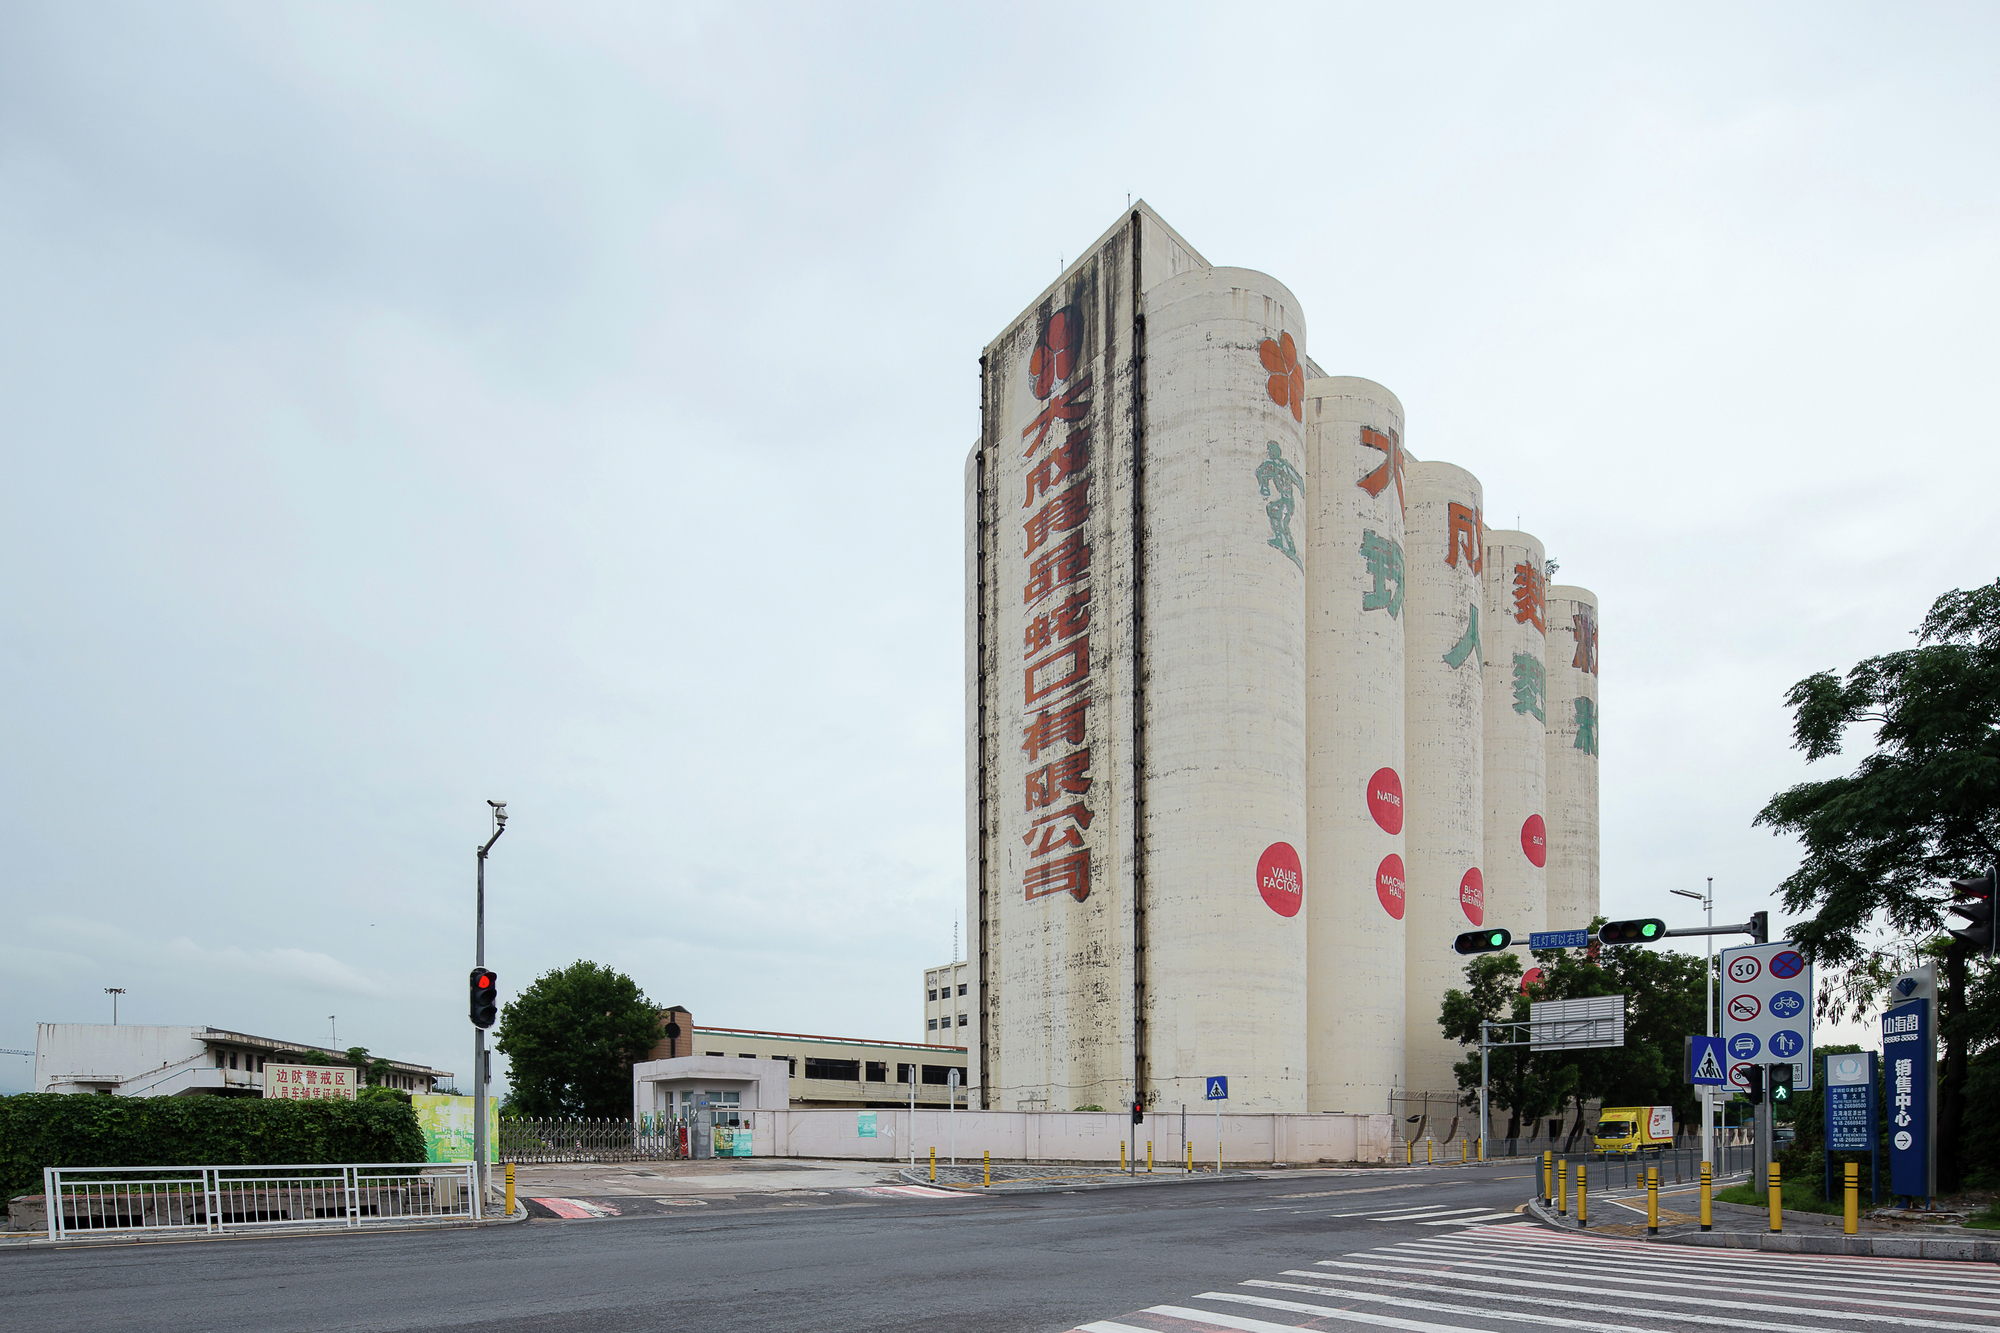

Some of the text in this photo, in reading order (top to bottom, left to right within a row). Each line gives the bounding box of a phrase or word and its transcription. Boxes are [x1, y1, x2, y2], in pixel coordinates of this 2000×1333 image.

[1377, 790, 1400, 807] NATURE
[1271, 866, 1297, 883] VALUE
[1263, 876, 1301, 895] FACTORY
[1389, 885, 1402, 899] HALL
[1532, 932, 1585, 947] 红灯可以右转
[1735, 963, 1755, 977] 30
[276, 1069, 346, 1086] 边防警戒区
[1895, 1059, 1912, 1127] 销售中心
